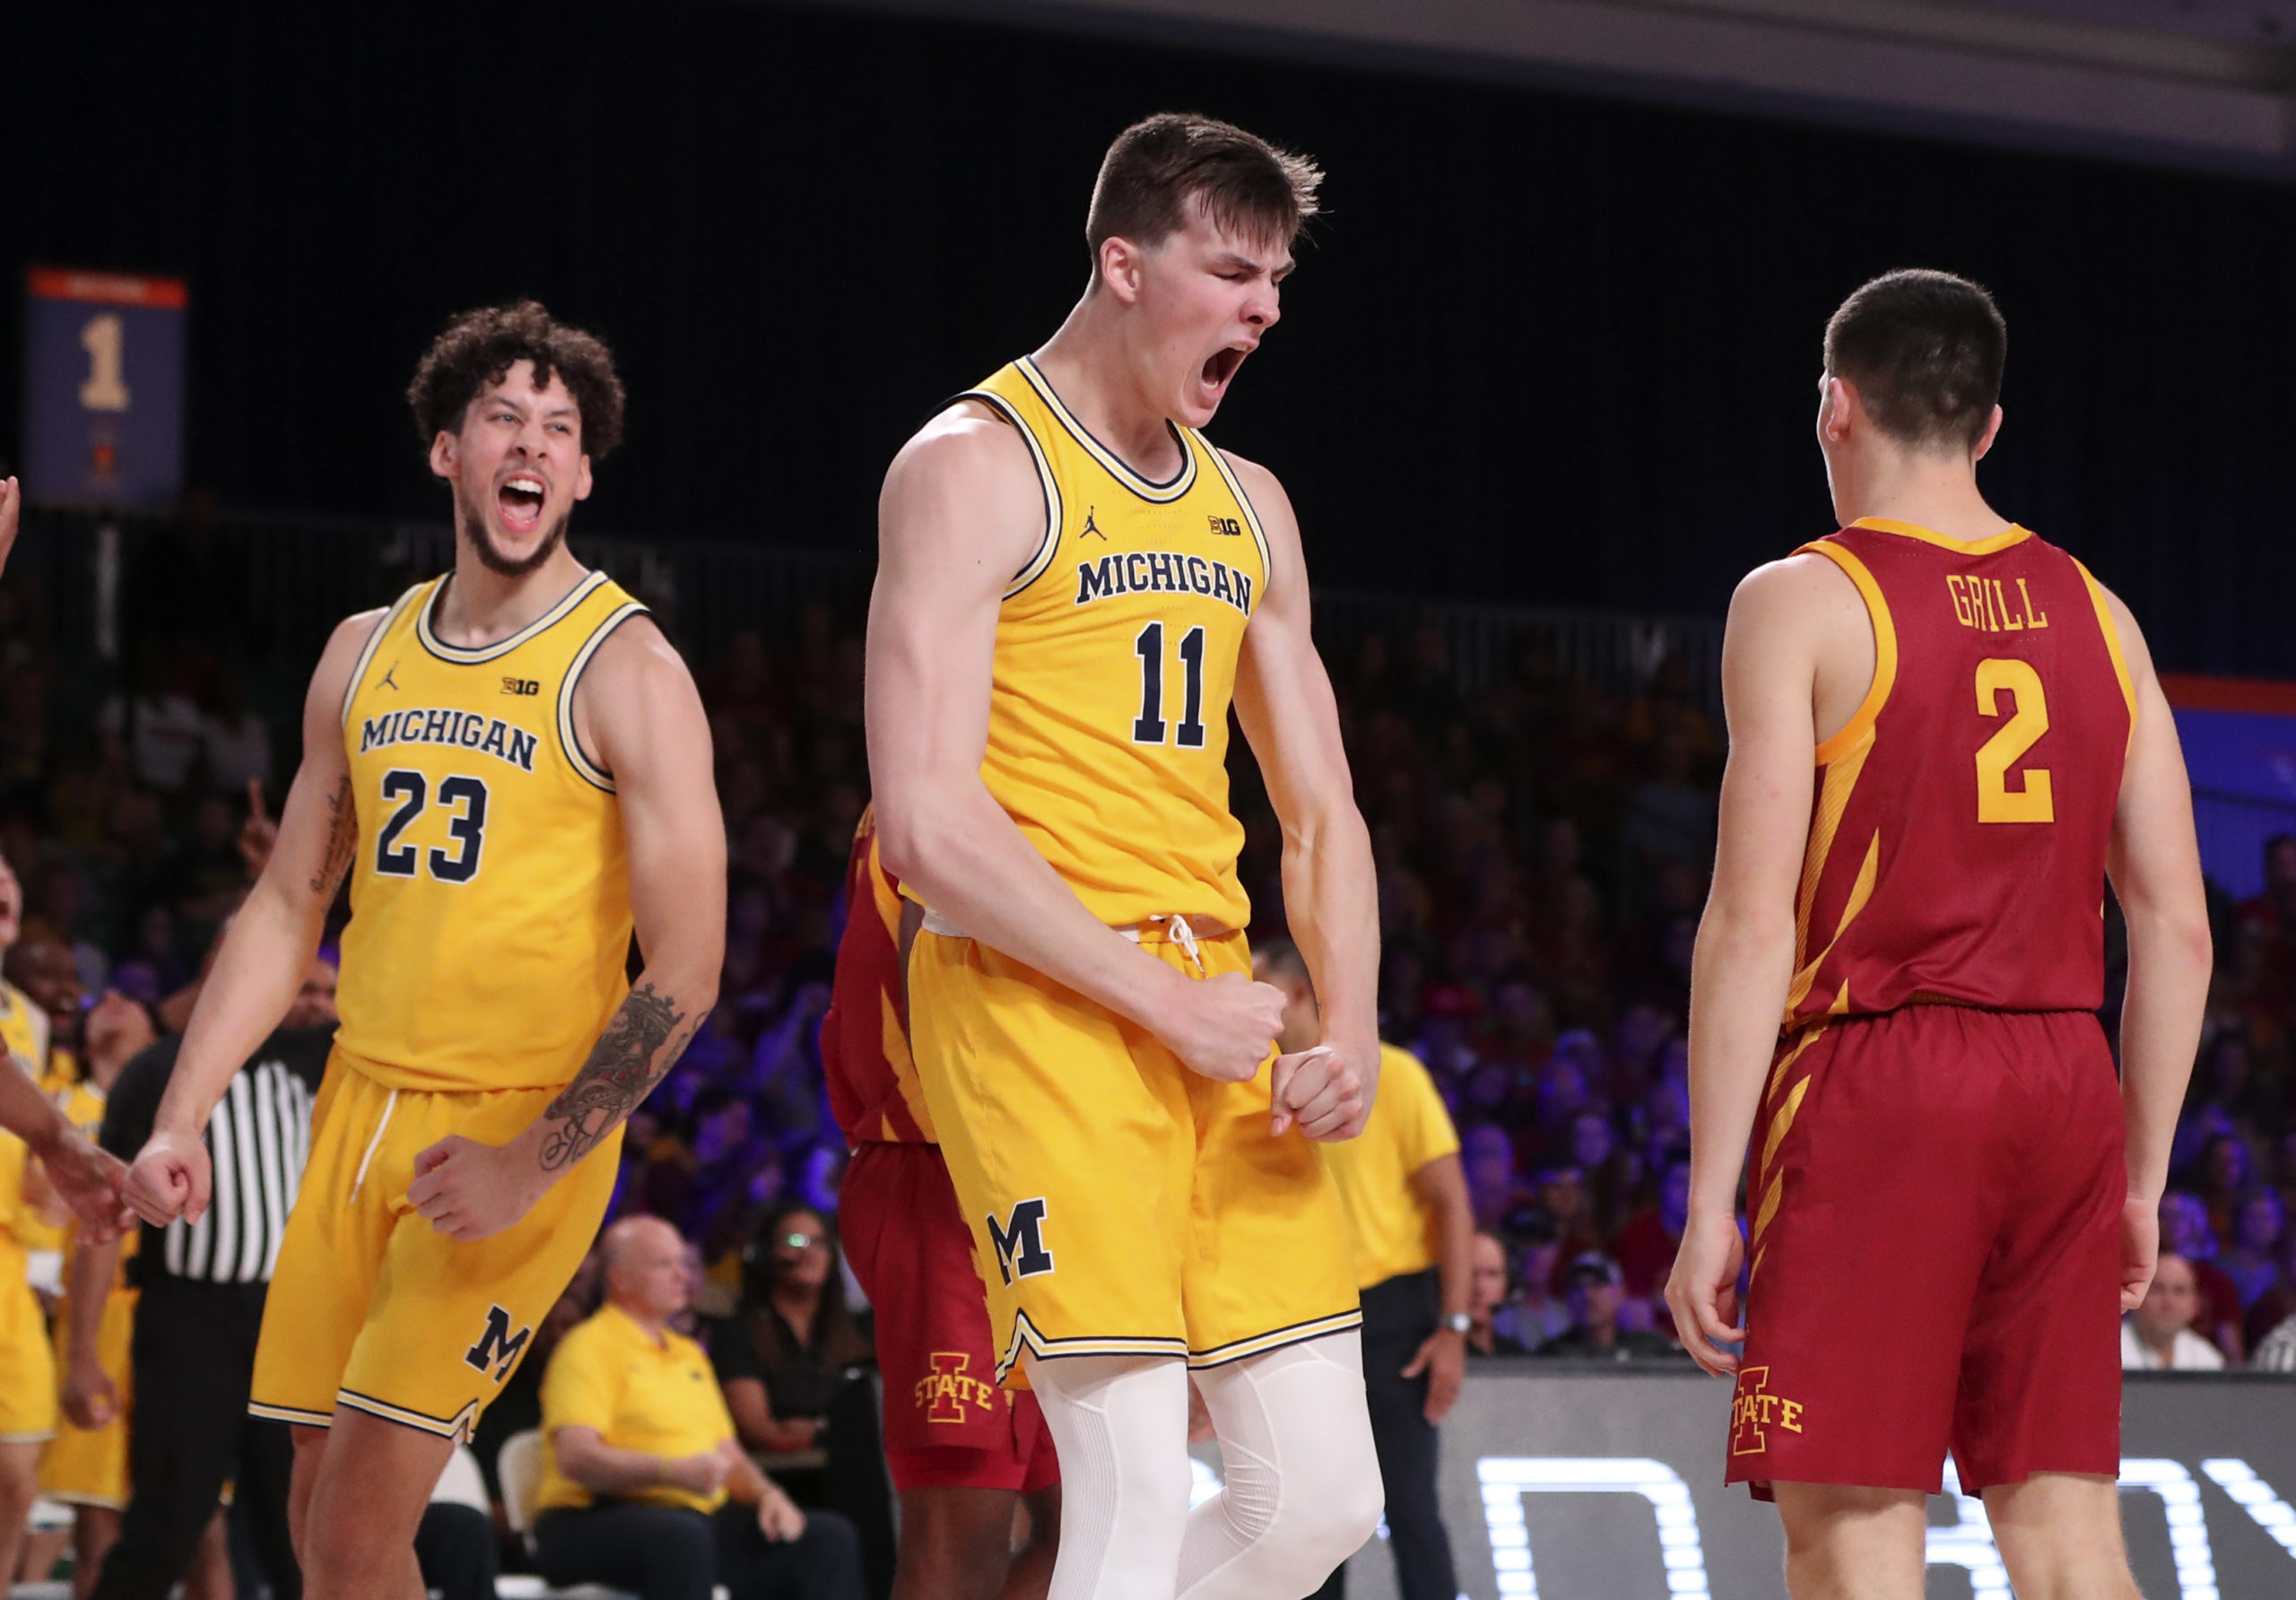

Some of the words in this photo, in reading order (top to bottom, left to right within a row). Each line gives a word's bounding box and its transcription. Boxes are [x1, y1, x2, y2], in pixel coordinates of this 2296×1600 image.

[80, 315, 128, 409] 1
[1075, 551, 1252, 620] MICHIGAN
[1946, 575, 2048, 631] GRILL
[1133, 620, 1205, 750] 11
[360, 708, 538, 774] MICHIGAN
[1975, 657, 2055, 823] 2
[375, 768, 490, 885] 23
[986, 1196, 1055, 1288] M
[464, 1303, 532, 1384] M
[915, 1375, 993, 1411] STATE
[1732, 1394, 1804, 1434] TATE
